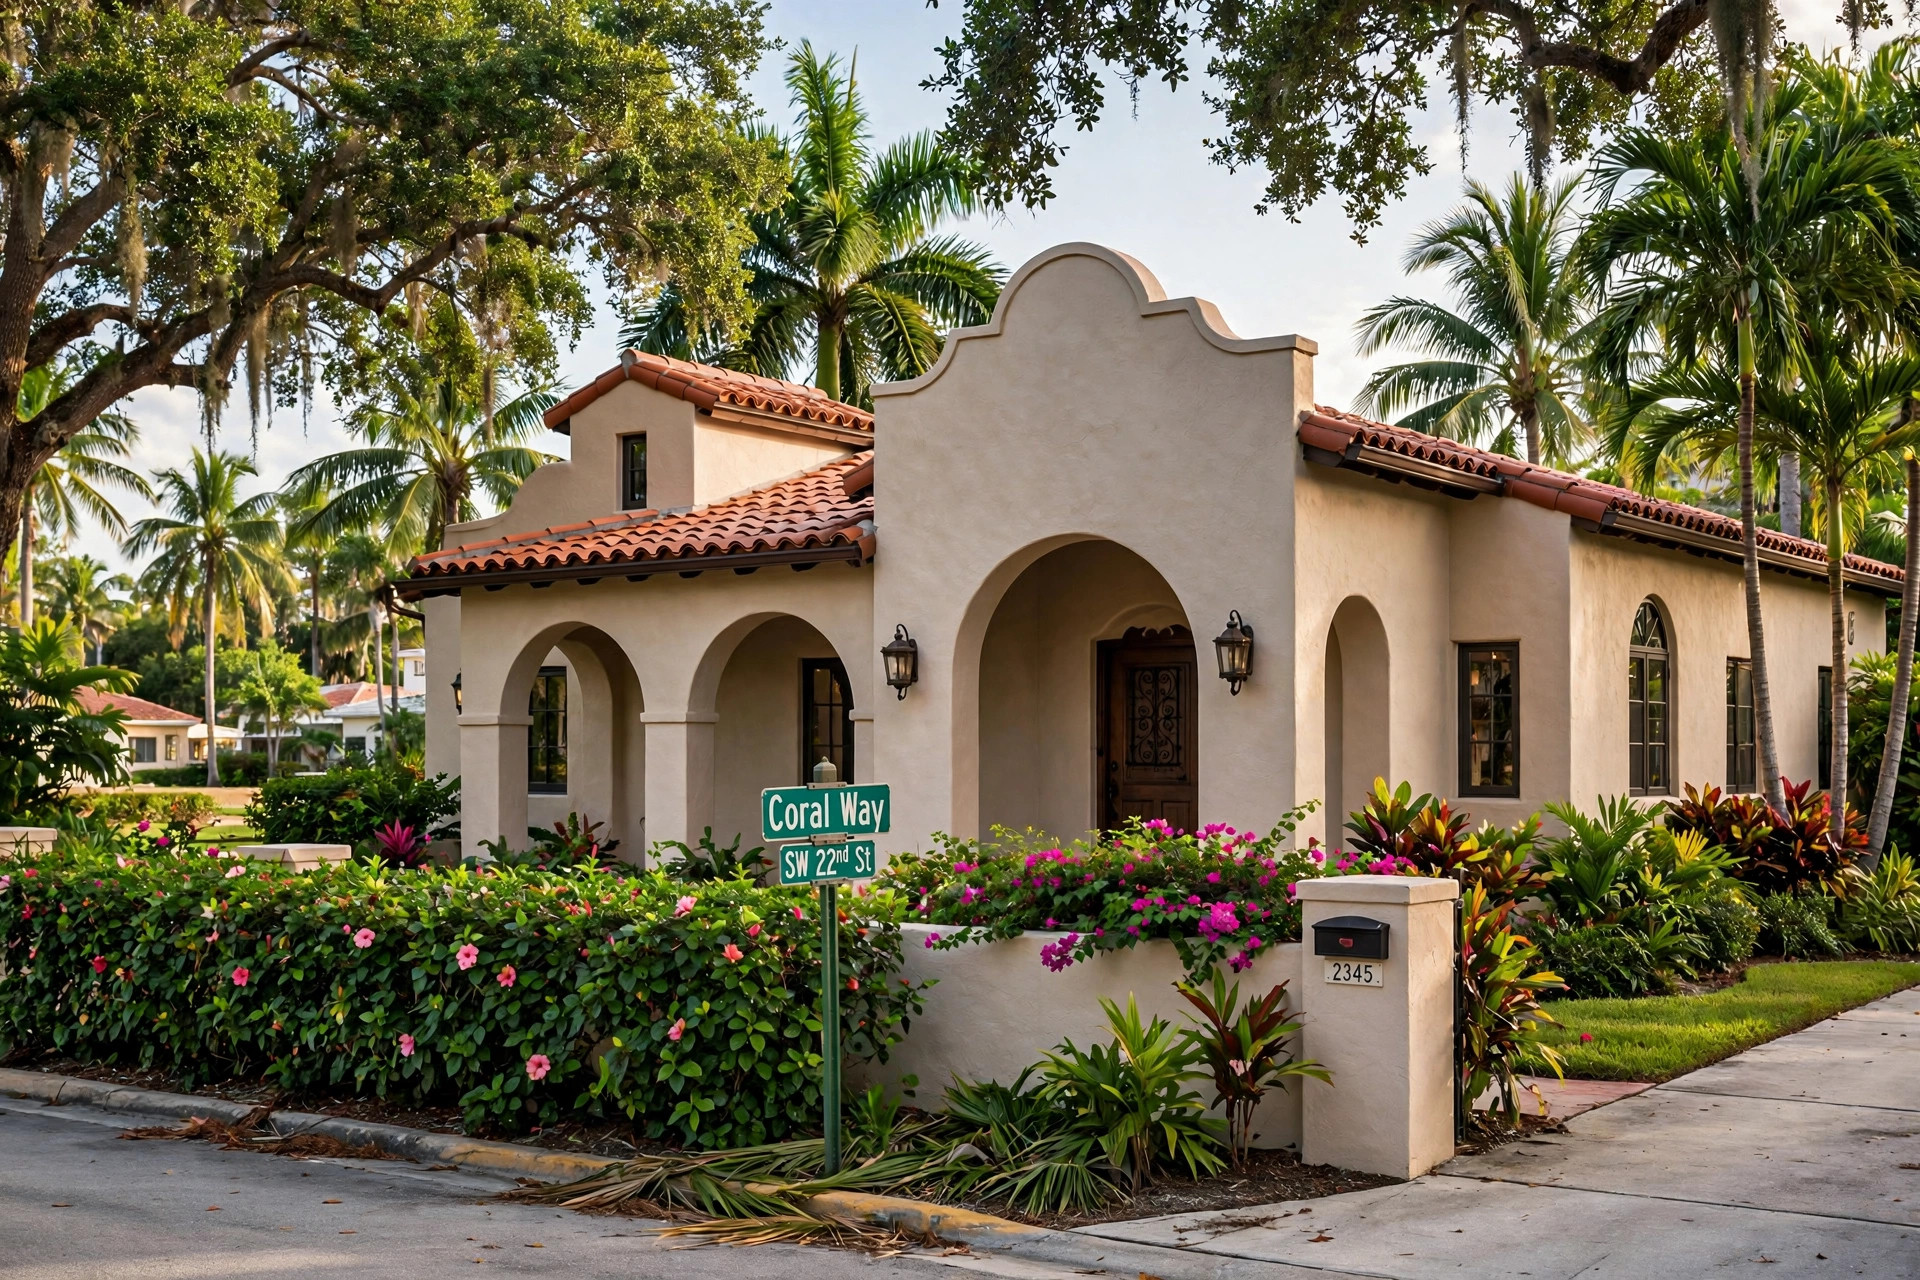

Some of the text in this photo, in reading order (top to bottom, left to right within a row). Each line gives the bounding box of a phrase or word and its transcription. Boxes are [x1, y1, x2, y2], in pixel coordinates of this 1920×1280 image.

[769, 792, 884, 832] Coral Way
[785, 845, 871, 879] SW 22nd St
[1333, 962, 1373, 983] 2345
